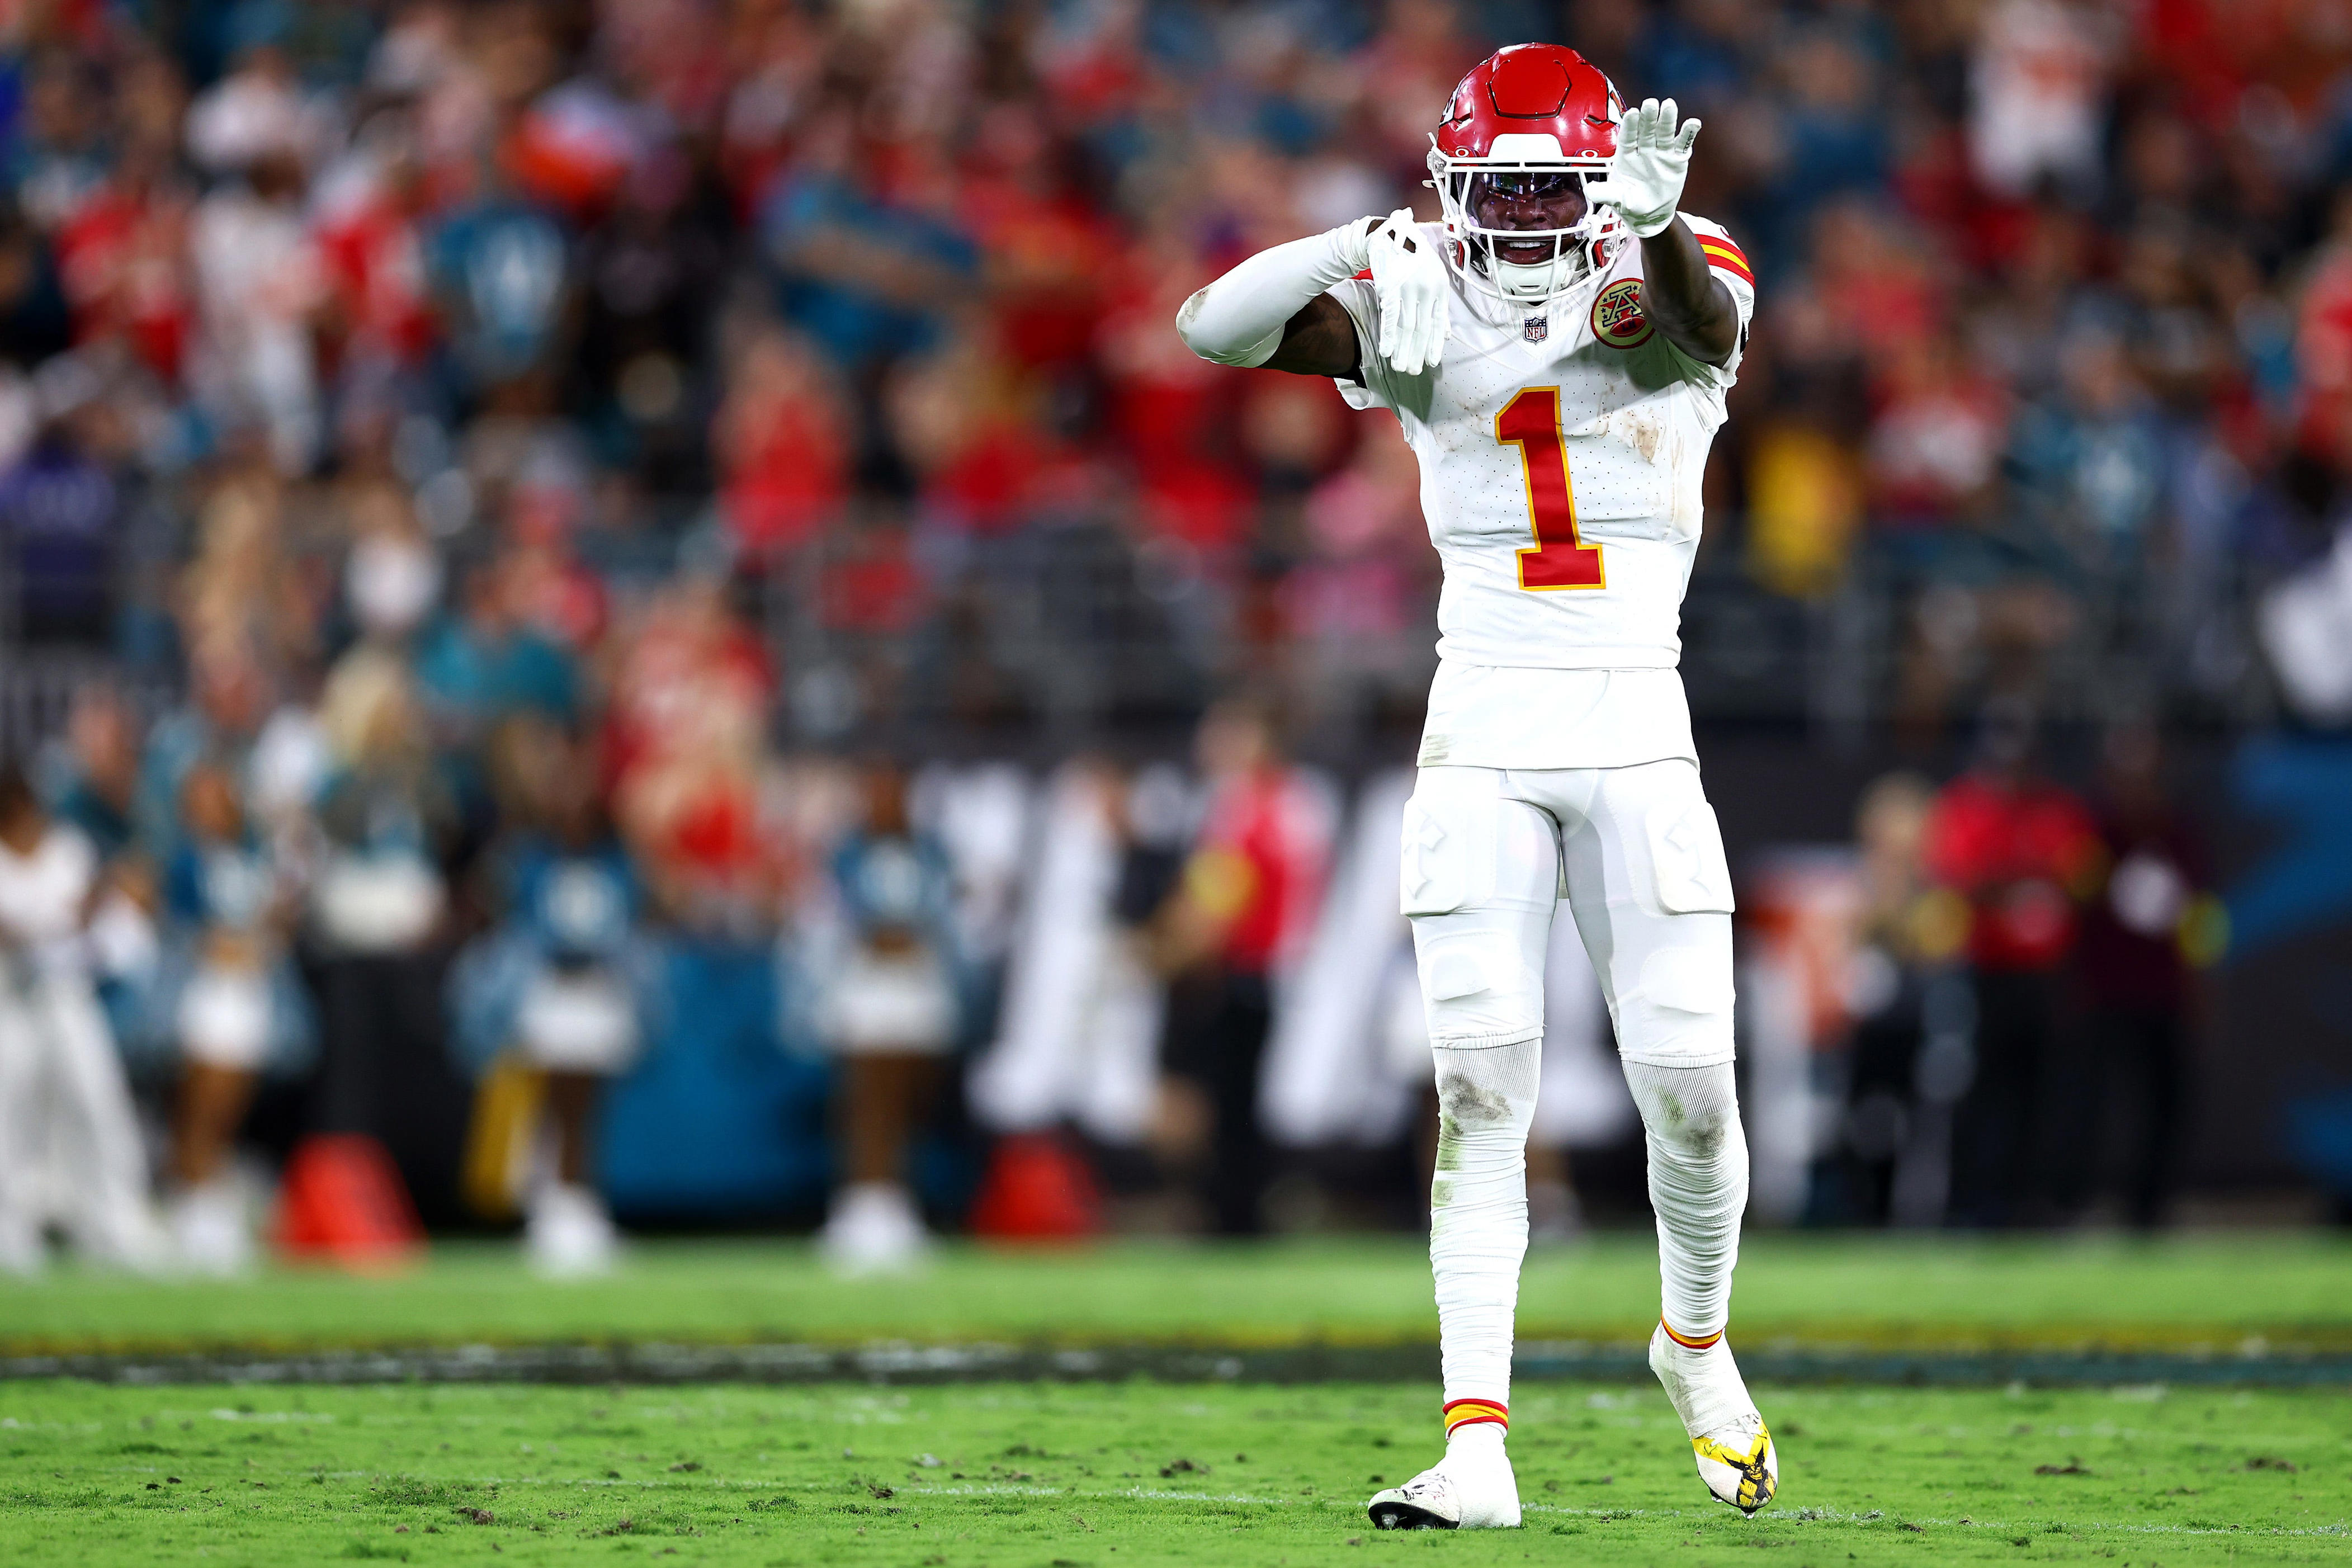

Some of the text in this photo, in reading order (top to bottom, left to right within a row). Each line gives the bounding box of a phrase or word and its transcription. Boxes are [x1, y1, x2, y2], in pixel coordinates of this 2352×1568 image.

[1602, 285, 1642, 328] A
[1527, 327, 1545, 339] NFL
[1495, 385, 1605, 592] 1
